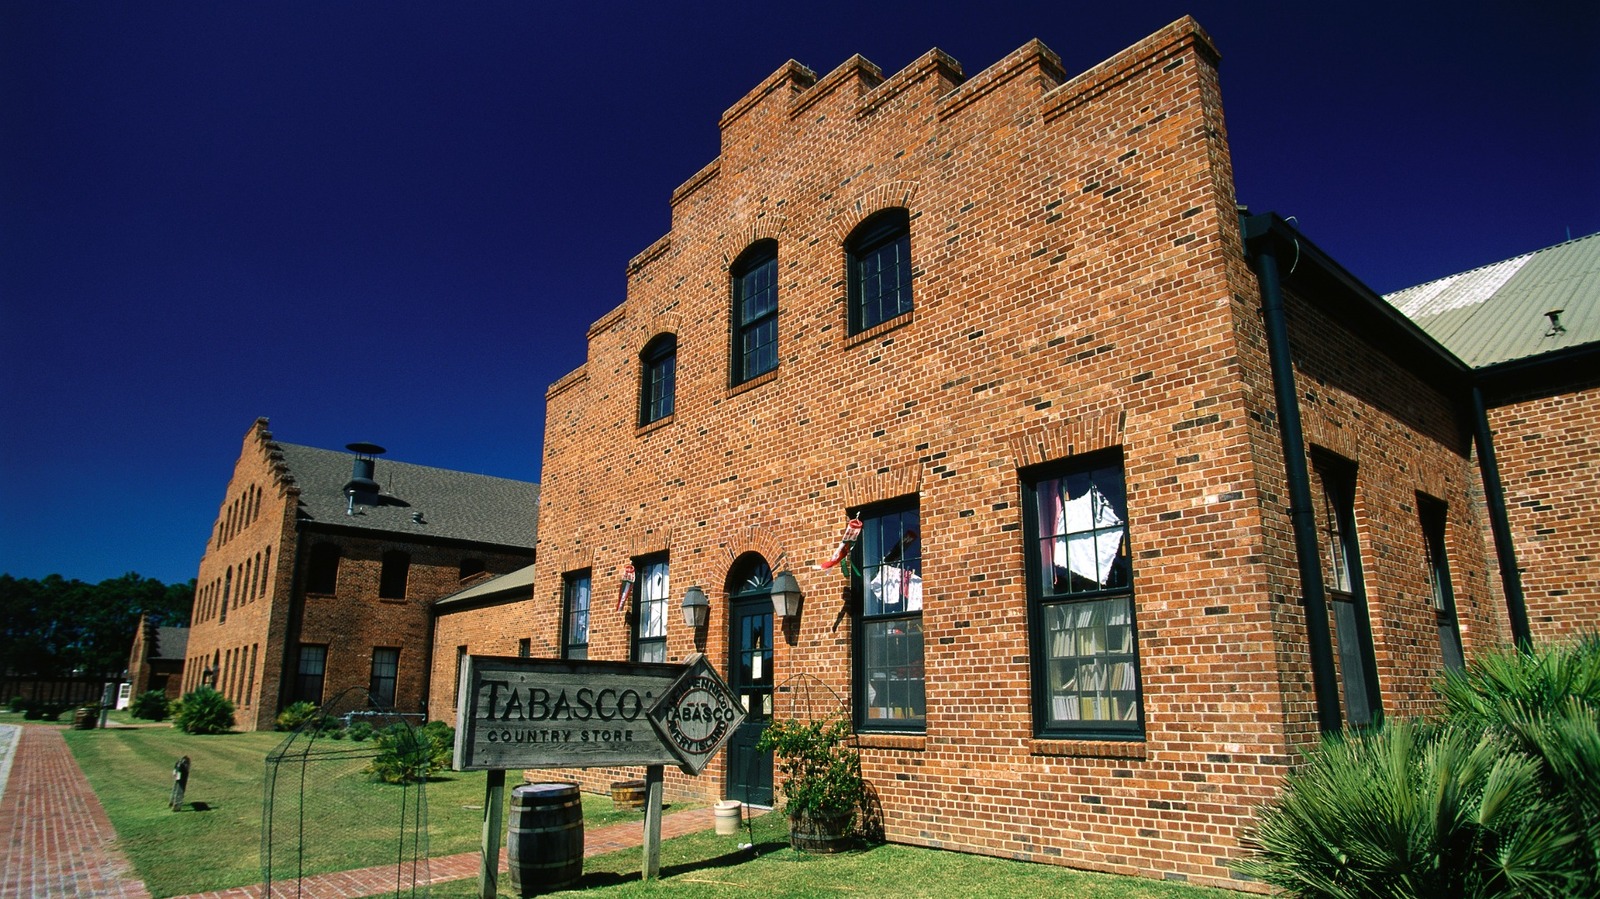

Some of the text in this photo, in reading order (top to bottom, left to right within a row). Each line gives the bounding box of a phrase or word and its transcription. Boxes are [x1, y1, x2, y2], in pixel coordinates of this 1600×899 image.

[480, 680, 643, 723] TABASCO
[664, 706, 735, 722] TABASCO
[487, 729, 633, 743] COUNTRY STORE
[694, 720, 726, 752] ISLAND
